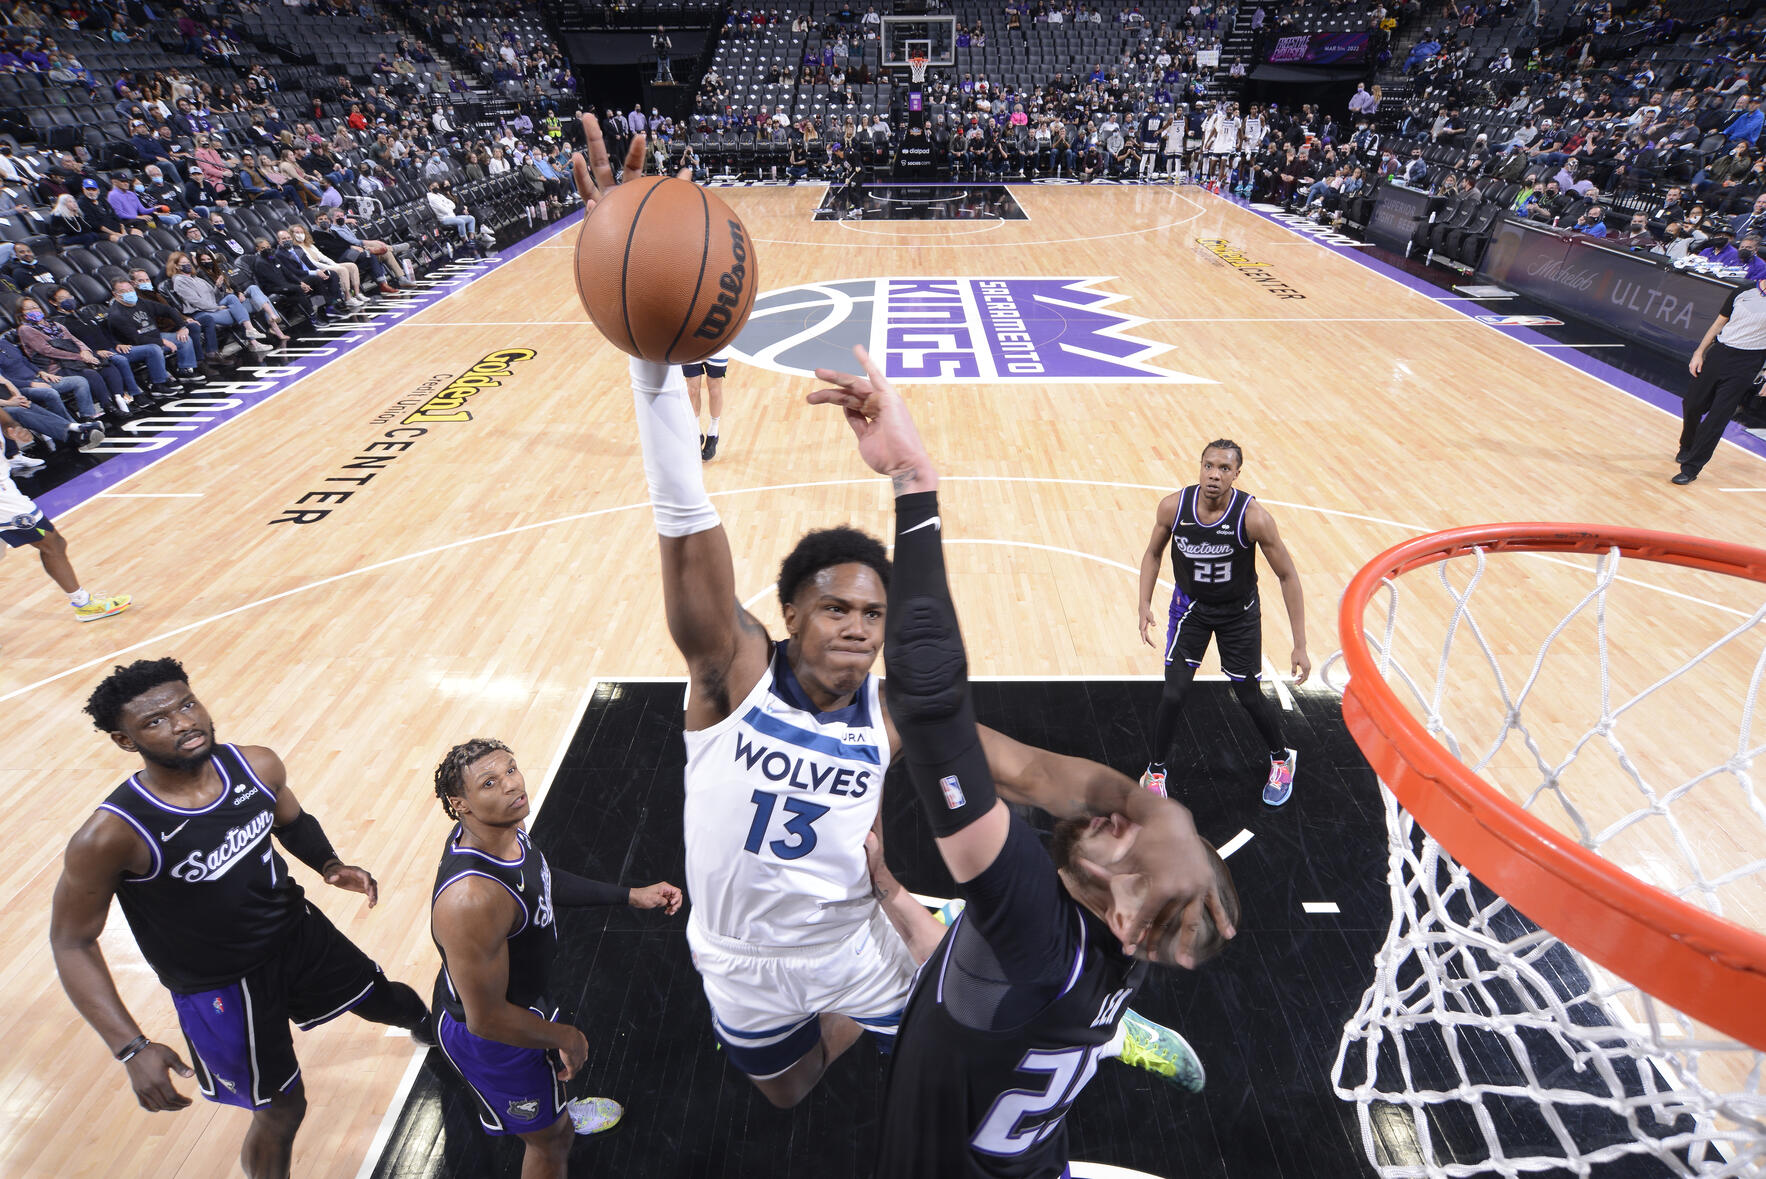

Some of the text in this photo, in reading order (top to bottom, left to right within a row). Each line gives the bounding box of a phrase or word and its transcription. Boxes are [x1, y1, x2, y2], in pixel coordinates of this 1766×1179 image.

[1382, 198, 1417, 217] SUPERIOR
[693, 219, 746, 340] Wilson
[1238, 267, 1307, 299] CENTER
[1527, 254, 1696, 329] Michelob ULTRA
[886, 280, 980, 377] KINGS
[979, 281, 1045, 373] SACRAMENTO
[78, 366, 307, 454] PROUD
[370, 373, 453, 425] Credit Union
[267, 427, 428, 526] CENTER
[1173, 534, 1234, 559] Sactown
[1194, 561, 1232, 583] 23
[233, 786, 258, 806] dialpad
[735, 731, 871, 798] WOLVES
[170, 809, 274, 883] Sactown
[743, 789, 831, 860] 13
